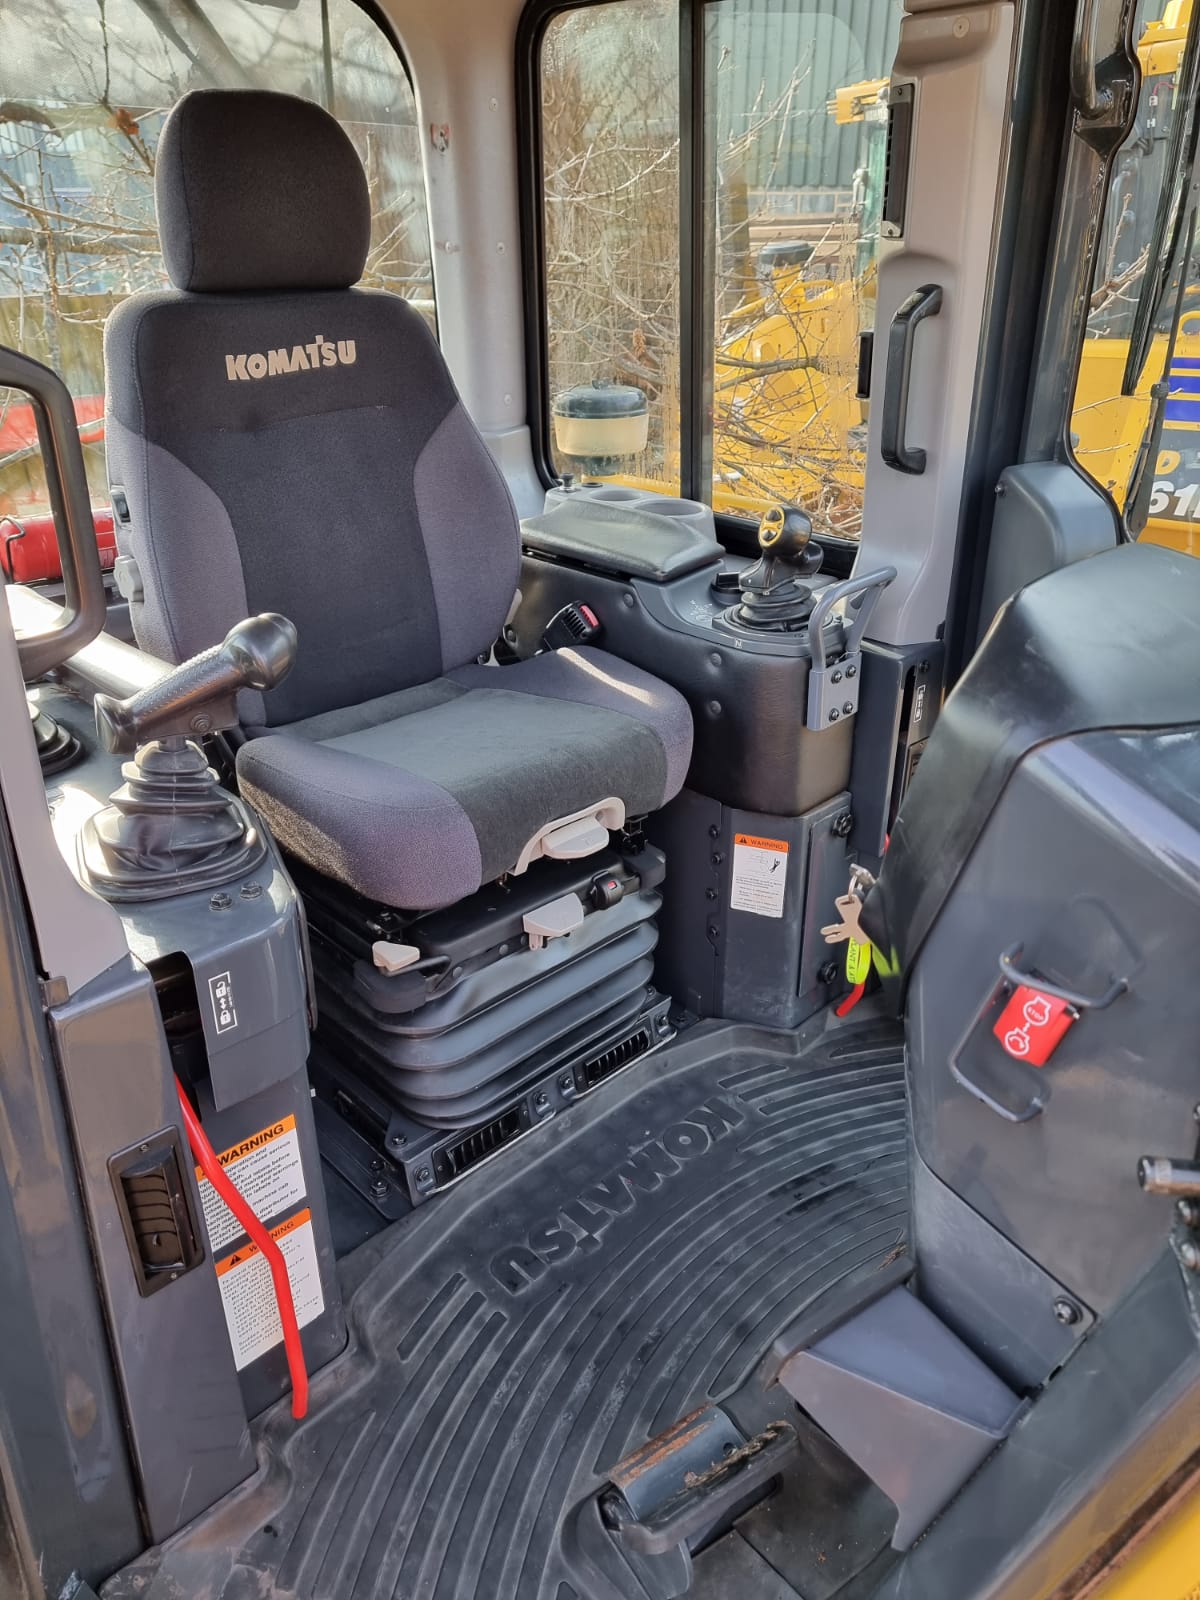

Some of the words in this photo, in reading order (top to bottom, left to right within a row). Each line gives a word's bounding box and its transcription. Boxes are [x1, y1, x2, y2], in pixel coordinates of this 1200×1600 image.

[225, 335, 357, 381] KOMATSU
[1149, 481, 1200, 518] 61
[751, 839, 784, 850] WARNING
[218, 1123, 284, 1166] WARNING
[489, 1097, 745, 1296] KOMATSU
[248, 1221, 294, 1253] WNING
